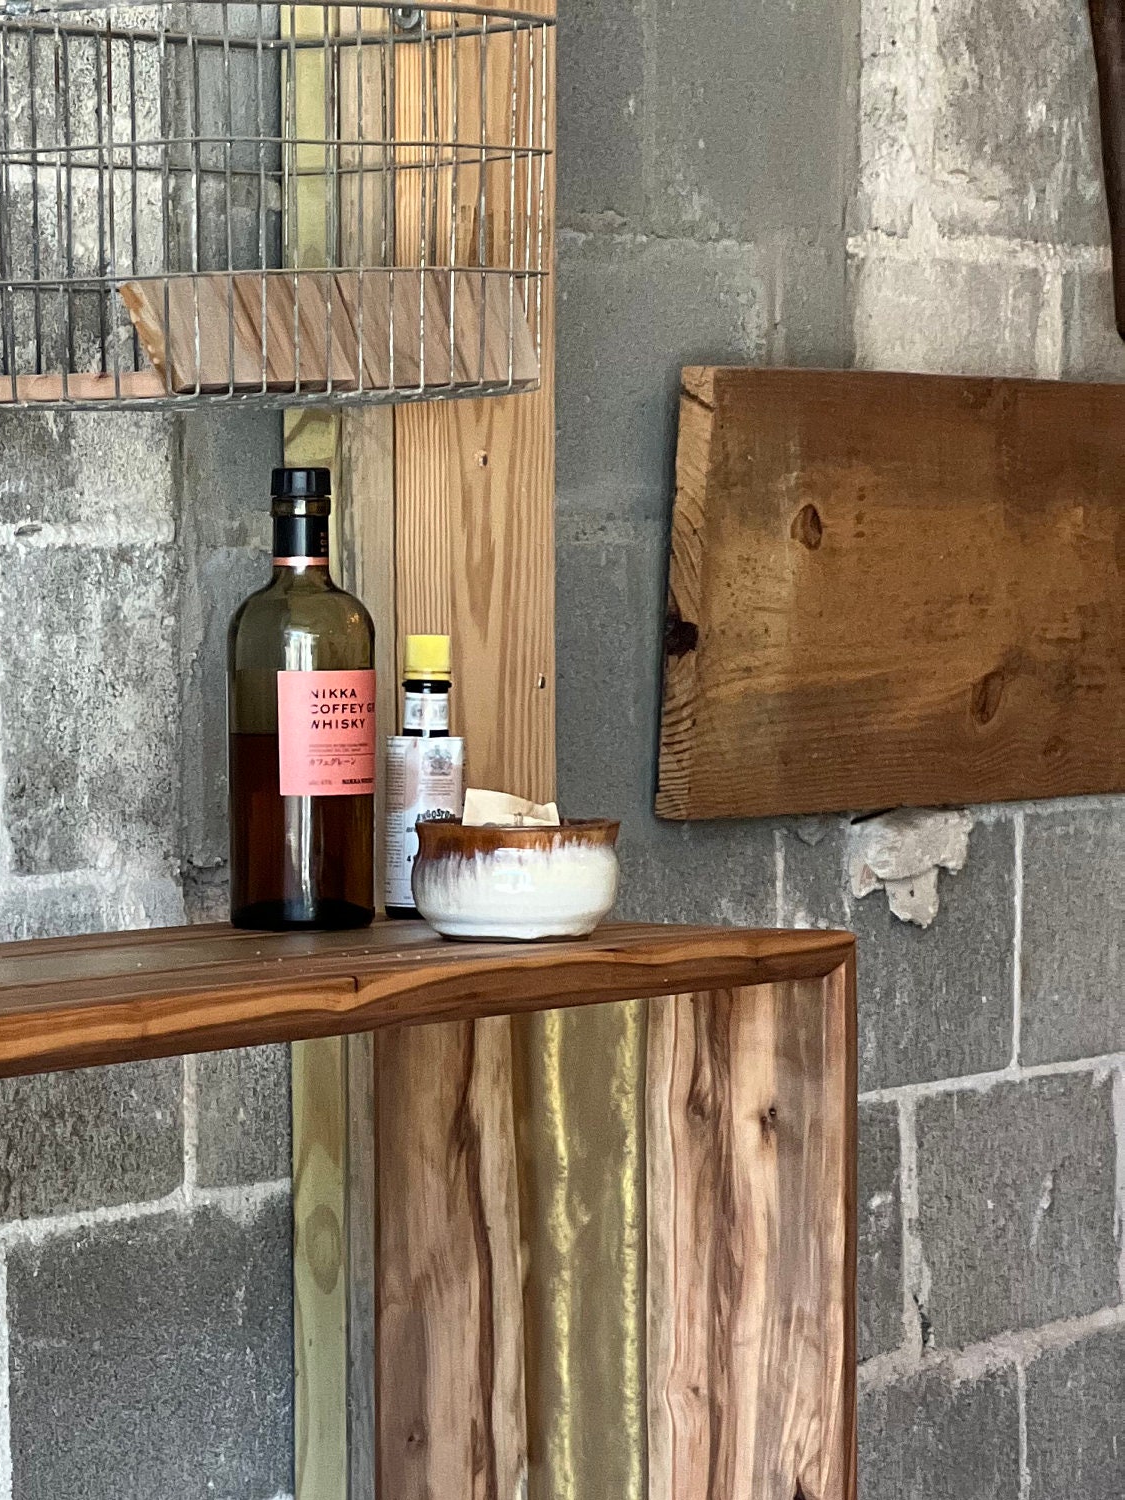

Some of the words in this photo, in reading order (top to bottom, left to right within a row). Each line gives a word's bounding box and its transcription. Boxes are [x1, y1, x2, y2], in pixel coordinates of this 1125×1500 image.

[310, 688, 357, 699] NIKKA
[310, 703, 364, 714] COFFEY
[310, 718, 365, 730] WHISKY
